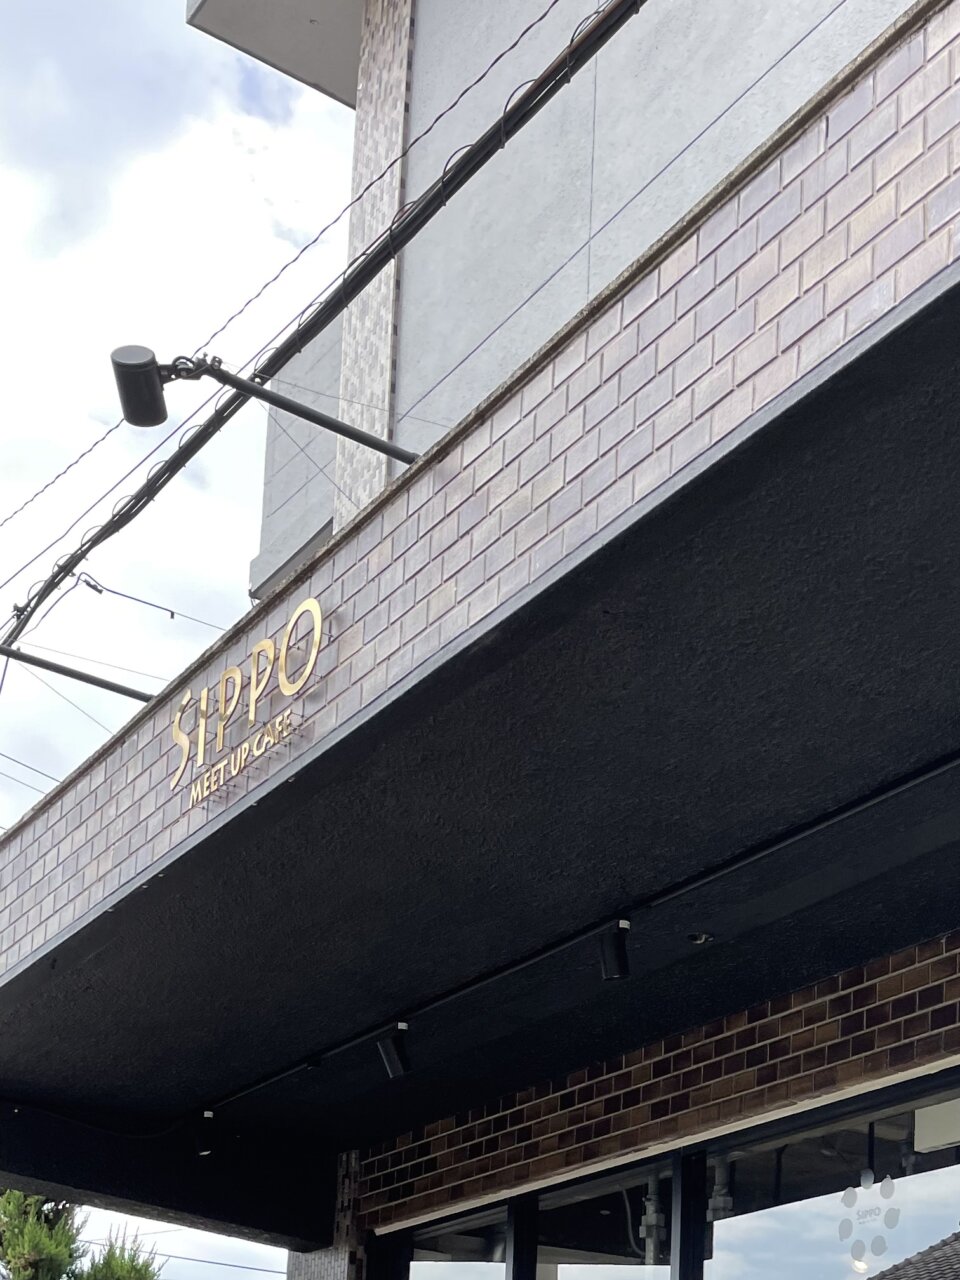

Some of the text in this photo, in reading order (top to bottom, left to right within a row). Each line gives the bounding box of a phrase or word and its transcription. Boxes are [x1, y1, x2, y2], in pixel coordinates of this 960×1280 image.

[170, 597, 322, 791] SIPPO
[189, 708, 293, 808] MEET UP CAFE
